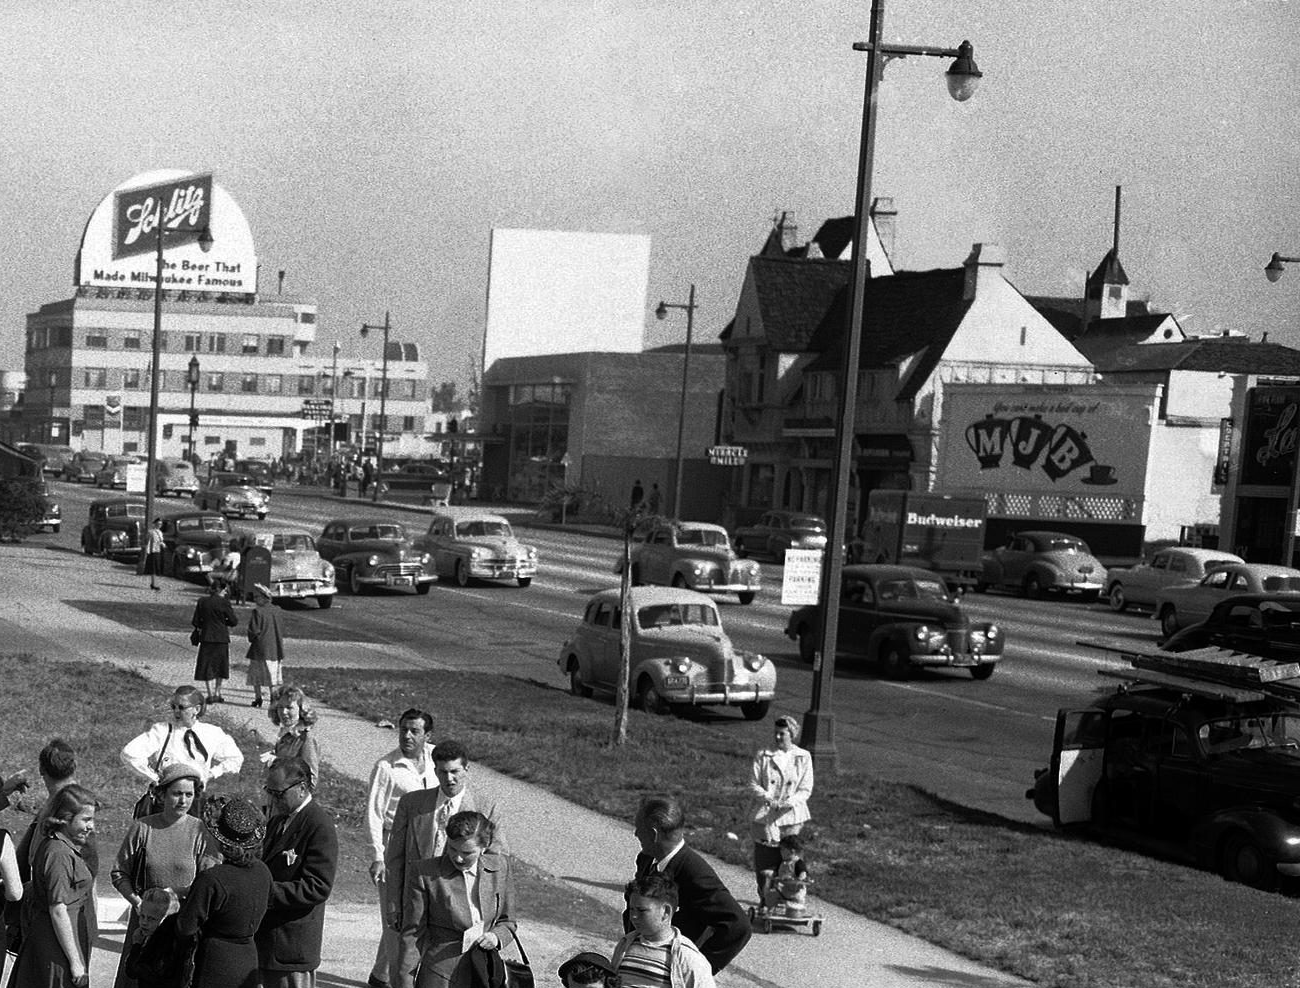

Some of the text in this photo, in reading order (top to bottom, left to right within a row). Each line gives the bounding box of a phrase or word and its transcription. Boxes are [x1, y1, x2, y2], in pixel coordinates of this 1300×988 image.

[182, 260, 209, 271] Beer
[215, 262, 241, 273] That
[94, 270, 125, 281] Made
[198, 276, 242, 287] Famous
[907, 512, 982, 528] Budweiser
